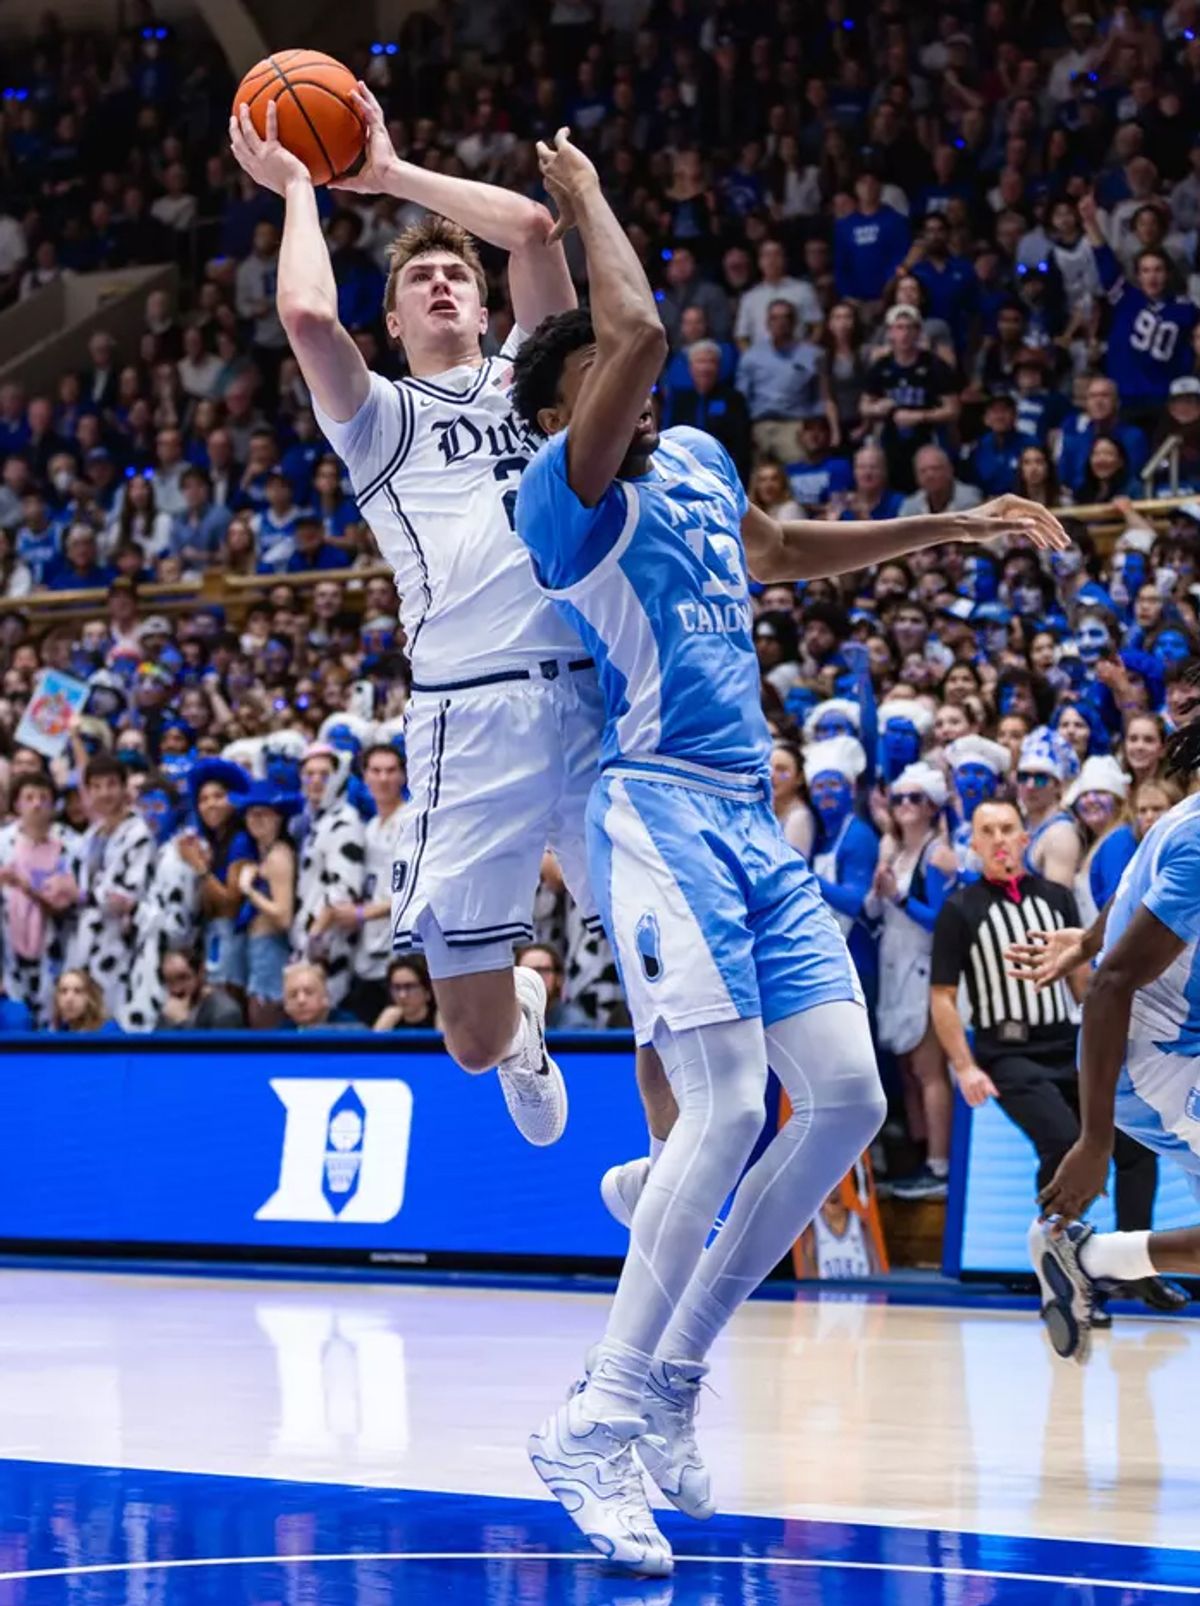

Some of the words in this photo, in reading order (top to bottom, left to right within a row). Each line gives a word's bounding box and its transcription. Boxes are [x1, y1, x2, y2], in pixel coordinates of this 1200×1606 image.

[1129, 310, 1179, 361] 90
[431, 412, 540, 467] Duk
[685, 528, 748, 600] 13
[253, 1077, 414, 1224] D
